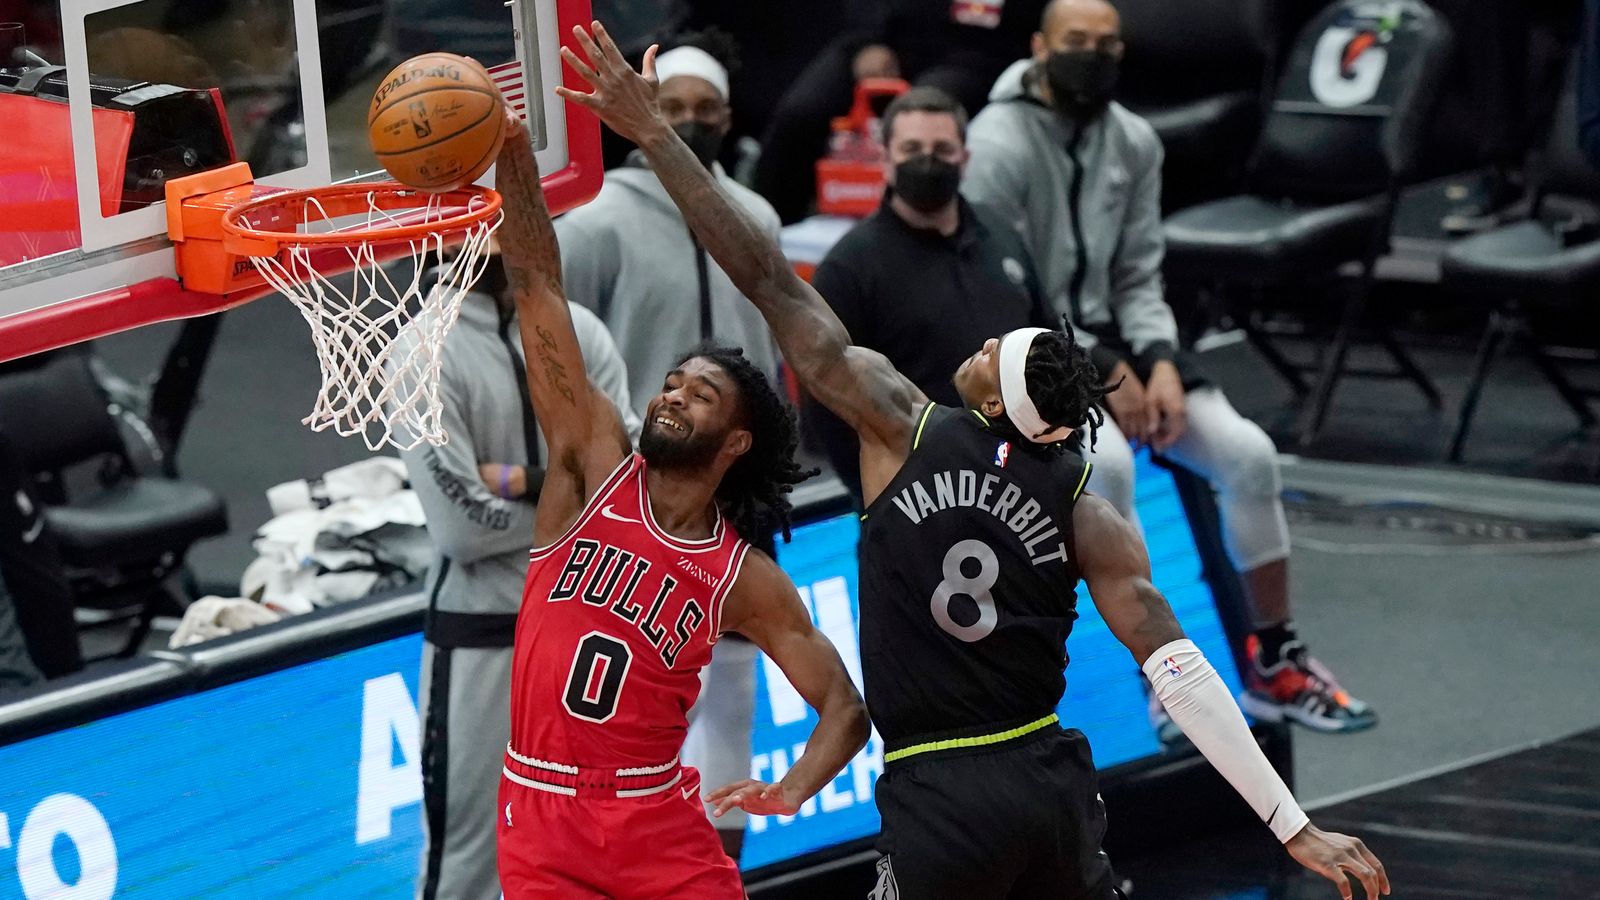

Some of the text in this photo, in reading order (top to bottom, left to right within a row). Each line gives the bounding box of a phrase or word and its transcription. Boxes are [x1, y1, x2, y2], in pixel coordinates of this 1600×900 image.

[375, 64, 465, 109] SPALDING
[423, 448, 512, 531] TIMBERWOLVES
[891, 469, 1068, 566] VANDERBILT
[547, 538, 705, 670] BULLS
[930, 539, 999, 642] 8
[561, 630, 634, 724] 0
